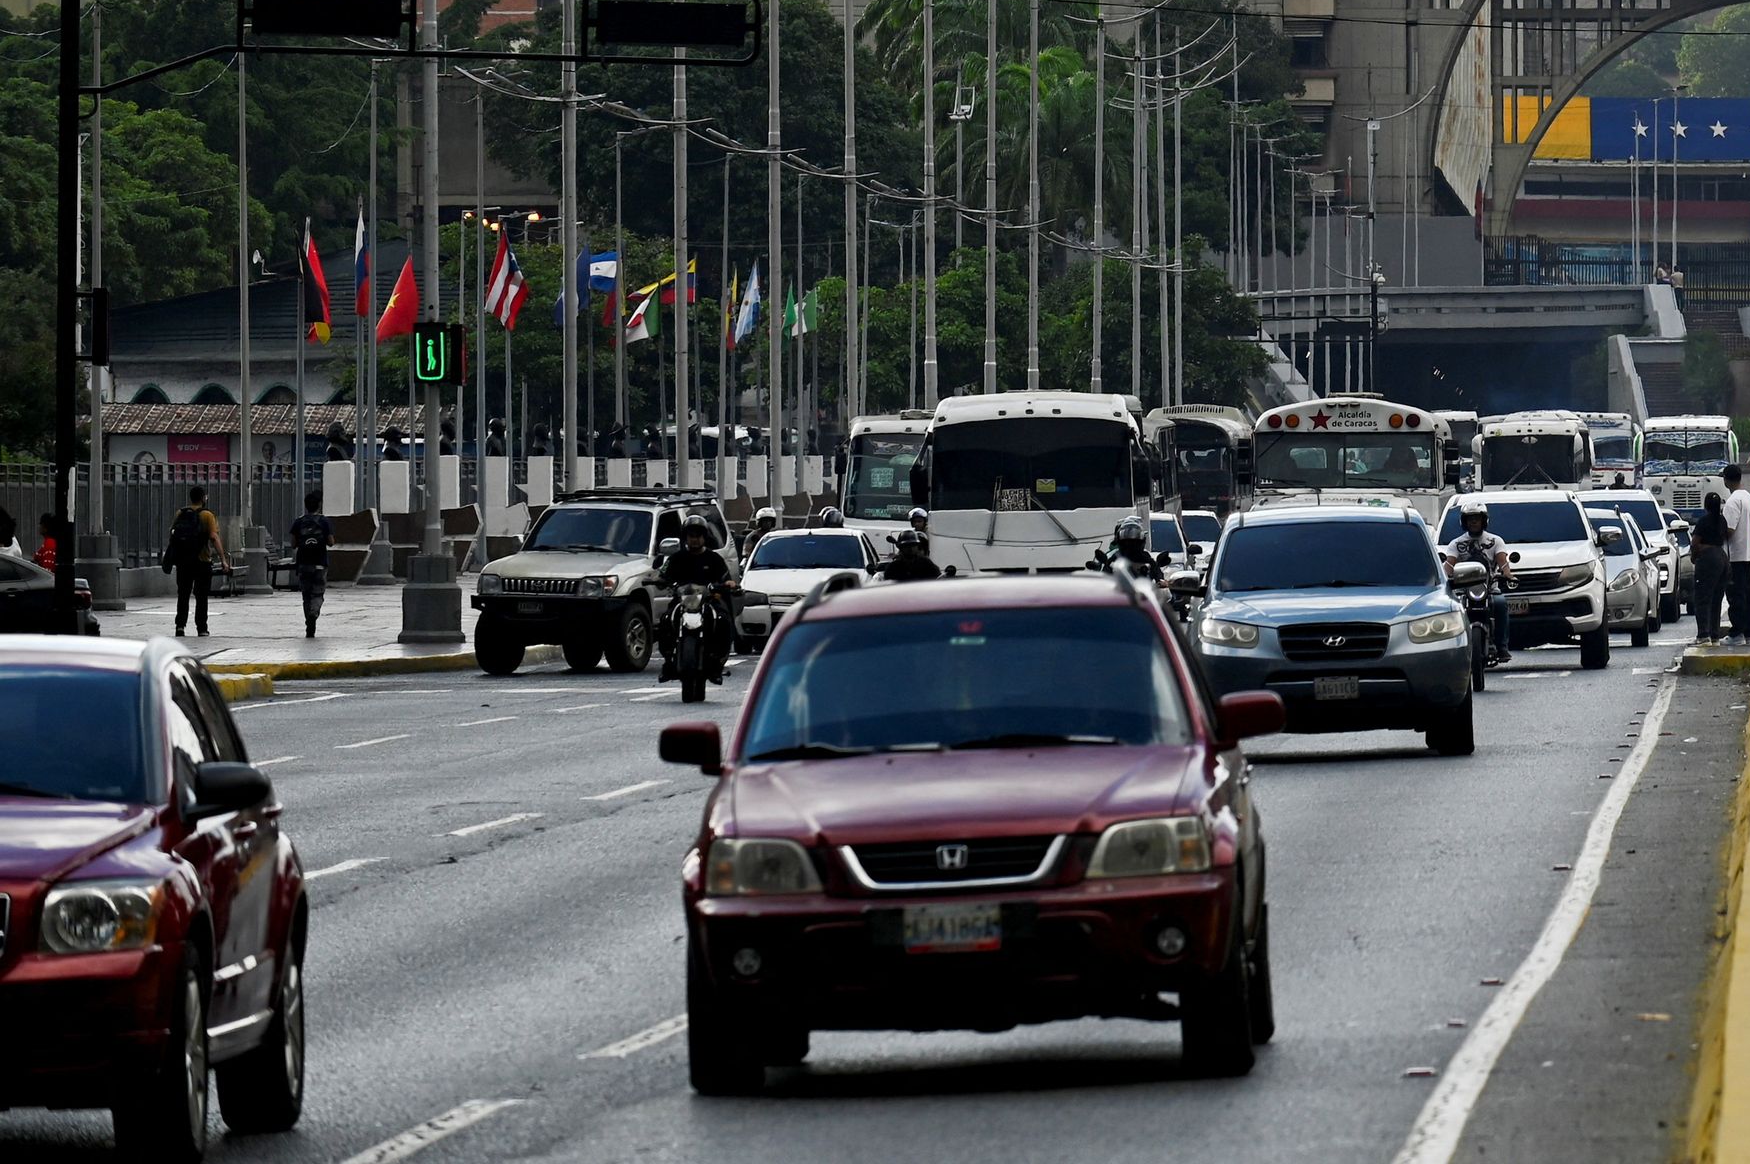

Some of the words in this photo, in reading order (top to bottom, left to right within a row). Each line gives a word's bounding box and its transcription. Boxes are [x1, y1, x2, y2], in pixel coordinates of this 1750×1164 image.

[1338, 410, 1372, 419] Alcaldía
[1344, 419, 1378, 428] Caracas
[184, 443, 199, 451] BDV
